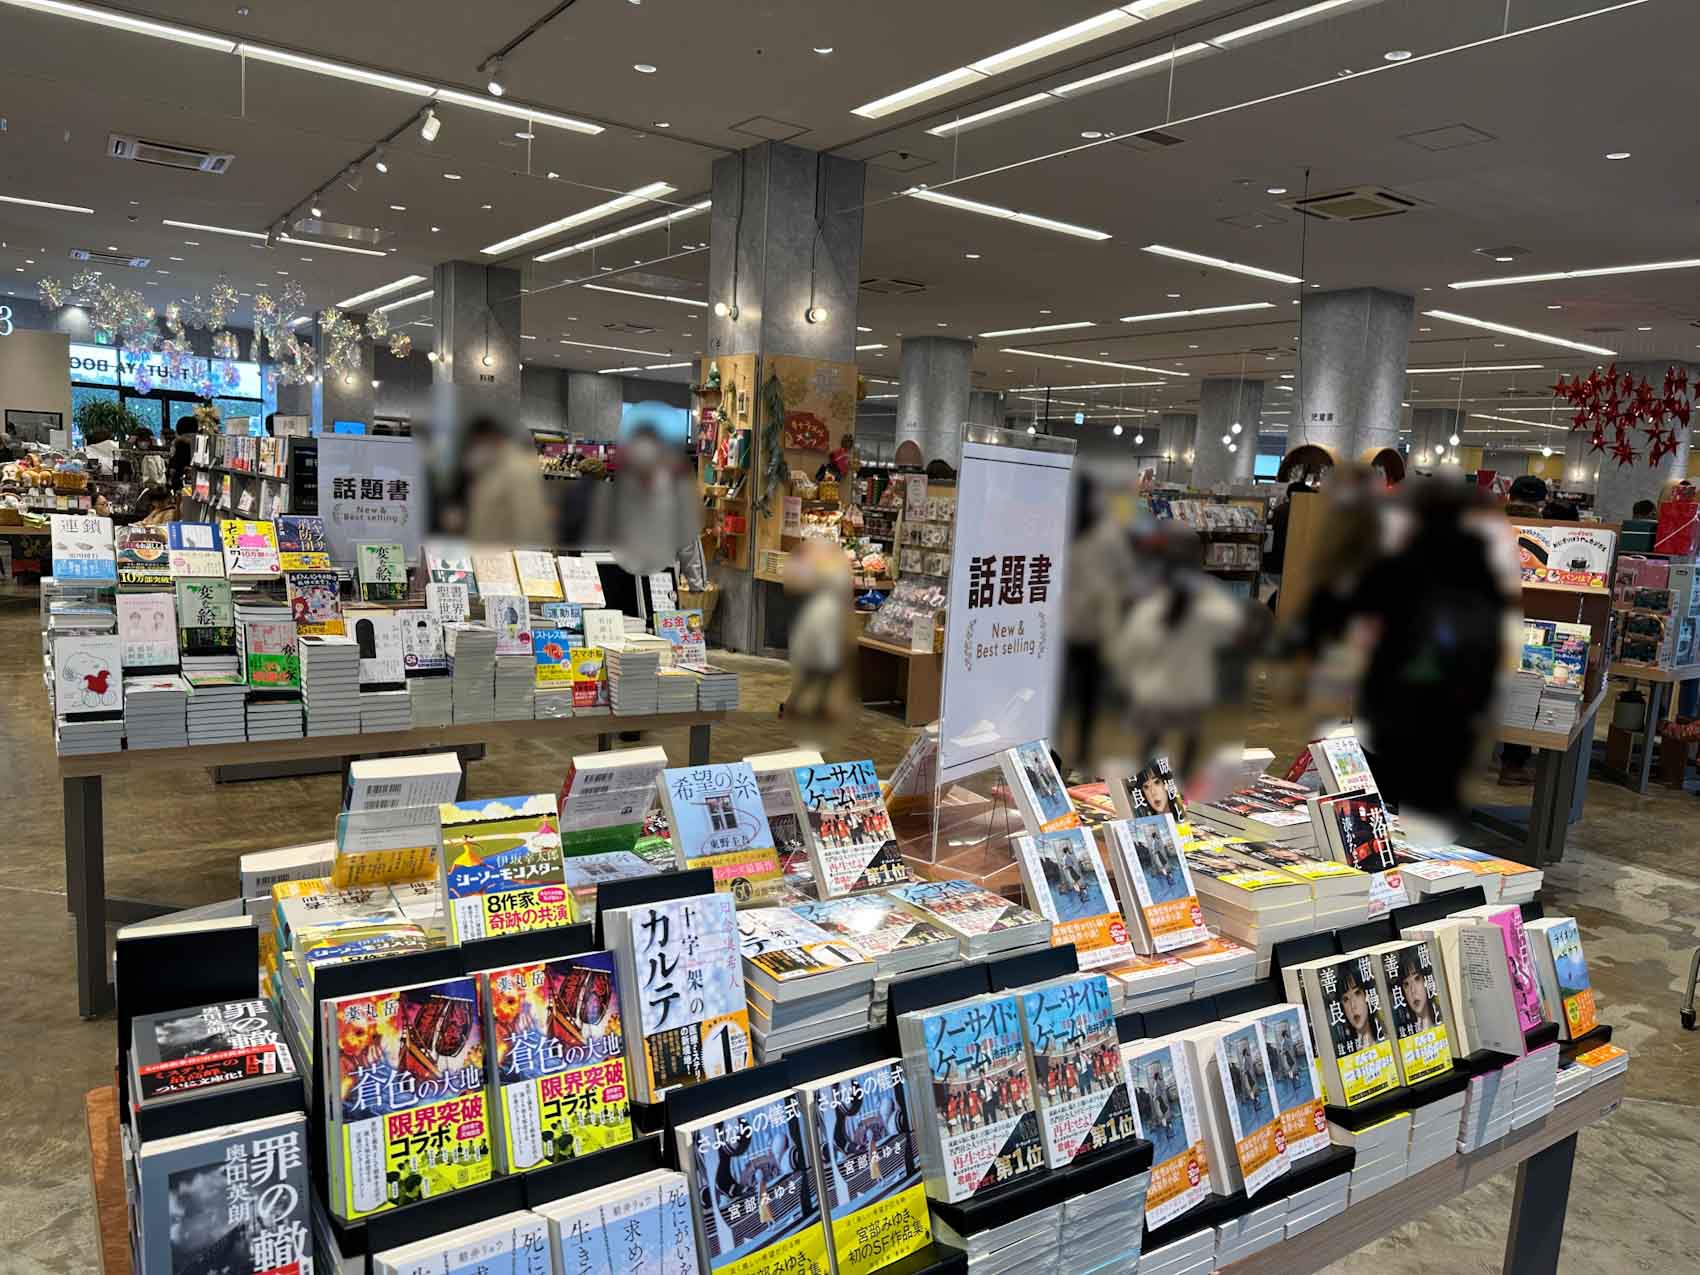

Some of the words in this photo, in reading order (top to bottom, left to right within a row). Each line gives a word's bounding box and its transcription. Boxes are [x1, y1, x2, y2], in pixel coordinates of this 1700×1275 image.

[332, 478, 410, 500] 話題書
[367, 513, 399, 523] selling
[968, 554, 1052, 609] 話題書
[976, 643, 998, 659] Best
[1002, 638, 1035, 655] selling
[991, 623, 1015, 639] New
[1018, 620, 1024, 635] &
[673, 768, 759, 801] 希望の糸
[808, 791, 856, 812] ゲーム
[709, 836, 751, 850] 東野圭吾
[1366, 807, 1395, 867] 落日
[455, 863, 563, 887] シーソーモンスター
[488, 904, 569, 930] 奇跡の共演
[641, 907, 681, 1030] カルテ
[680, 907, 705, 1014] 十字架の
[1319, 968, 1347, 1026] 善良
[1357, 956, 1387, 1042] 傲慢と
[1383, 954, 1408, 1010] 善良
[1416, 943, 1444, 1027] 傲慢と
[504, 1031, 623, 1076] 蒼色の大地
[1035, 1020, 1086, 1056] ゲーム
[540, 1062, 625, 1099] 限界突破
[935, 1042, 993, 1082] ゲーム
[349, 1063, 481, 1112] 蒼色の大地
[543, 1088, 599, 1119] コラボ
[818, 1066, 906, 1111] さよならの儀式
[387, 1096, 483, 1137] 限界突破
[697, 1099, 801, 1153] さよならの儀式
[1089, 1114, 1136, 1150] 第1位
[389, 1125, 453, 1159] コラボ
[994, 1143, 1045, 1181] 第1位
[225, 1143, 251, 1225] 奥田英朗
[250, 1131, 309, 1273] 罪の轍
